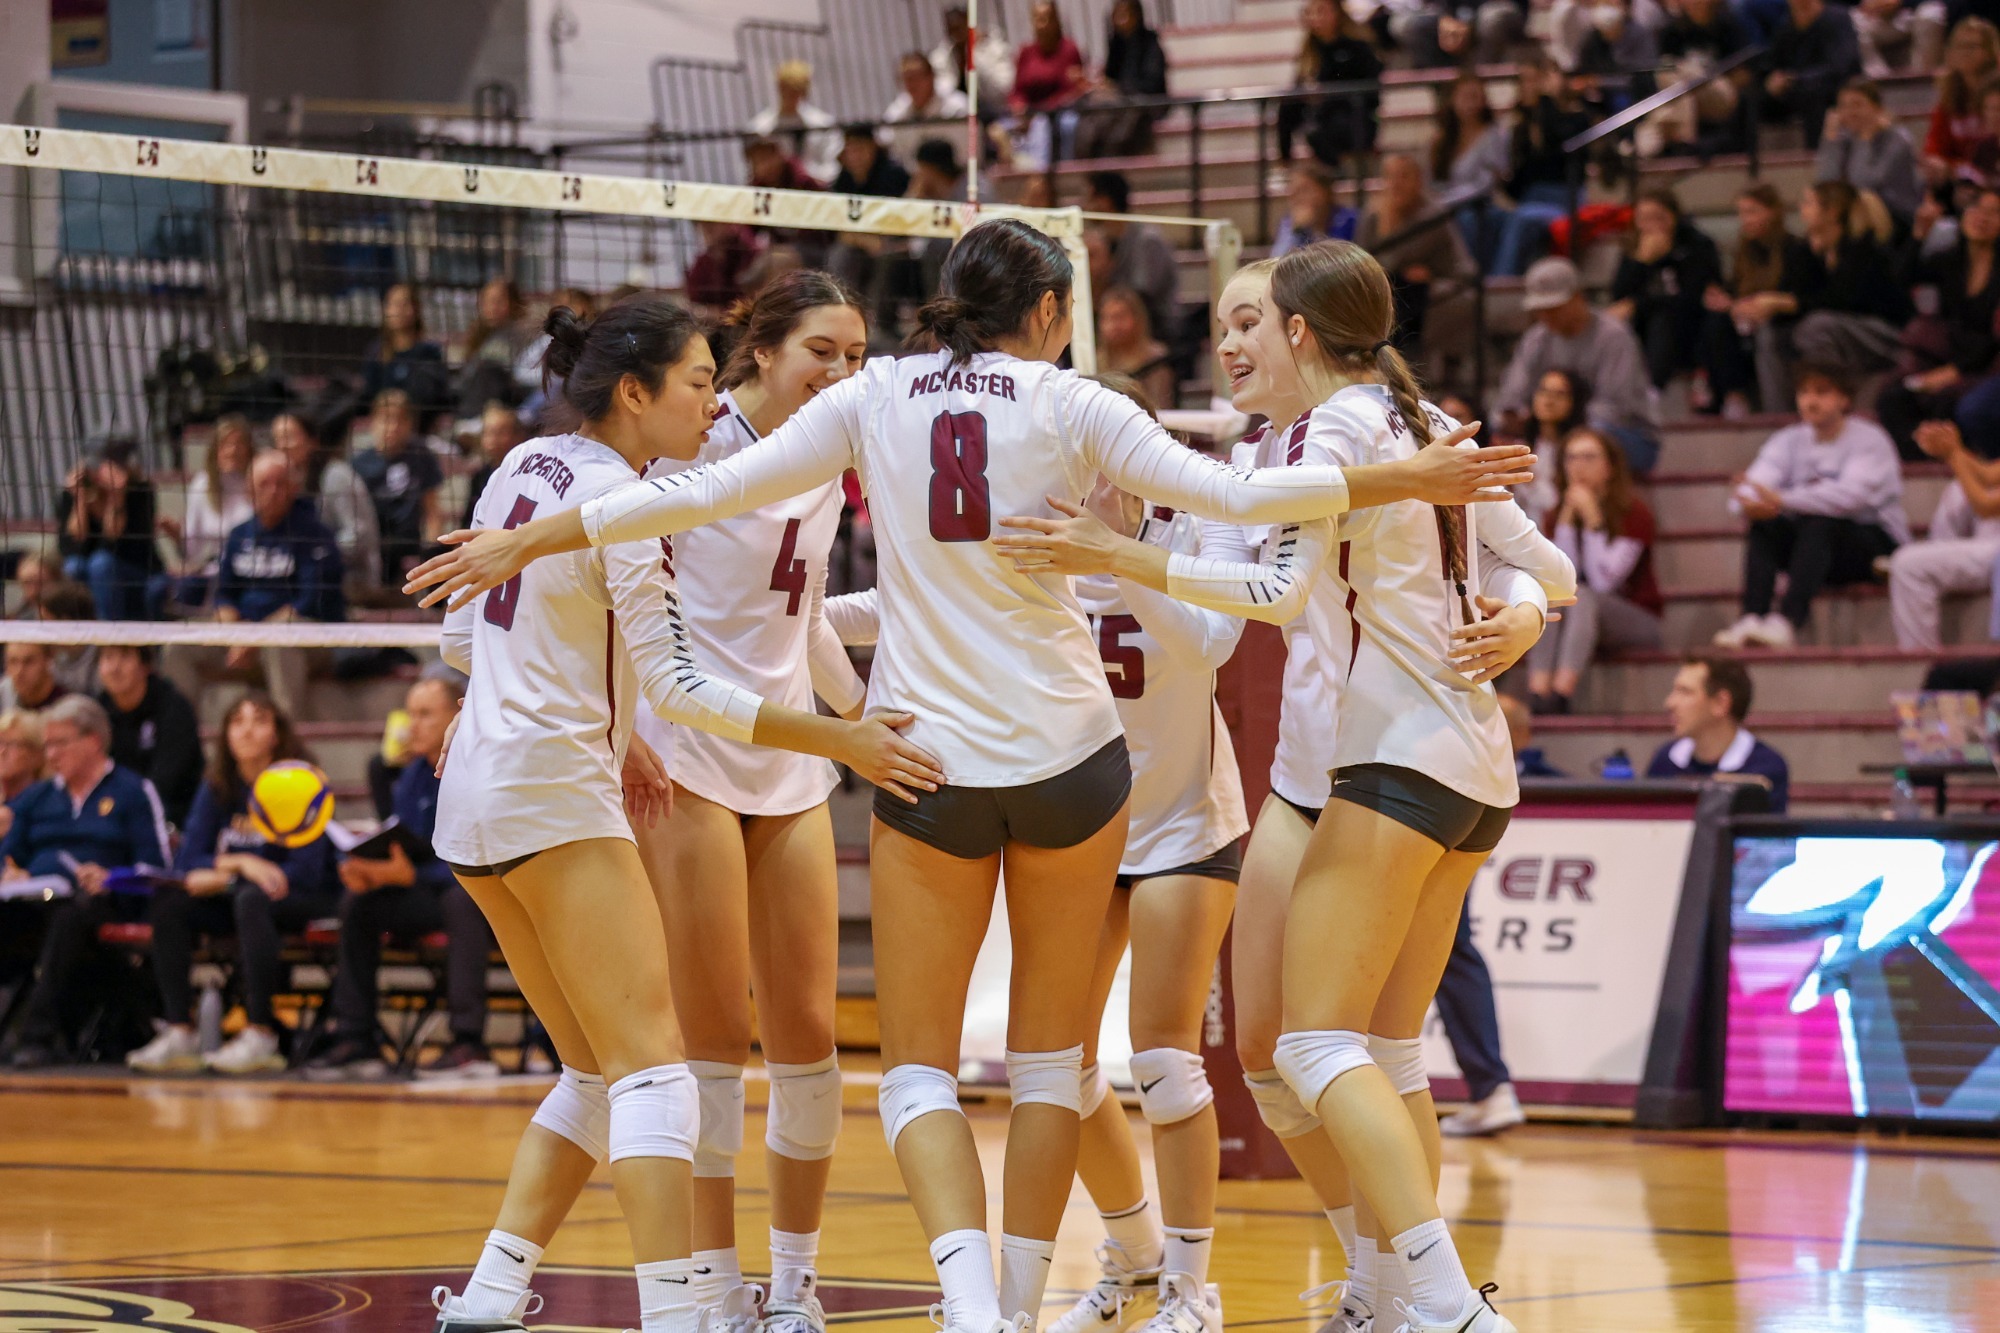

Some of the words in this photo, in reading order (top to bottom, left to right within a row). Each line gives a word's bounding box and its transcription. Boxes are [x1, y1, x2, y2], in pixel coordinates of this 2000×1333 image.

[929, 409, 991, 542] 8
[768, 517, 808, 617] 4
[1086, 612, 1146, 700] 5
[1487, 857, 1596, 903] ER
[1471, 917, 1577, 952] RS
